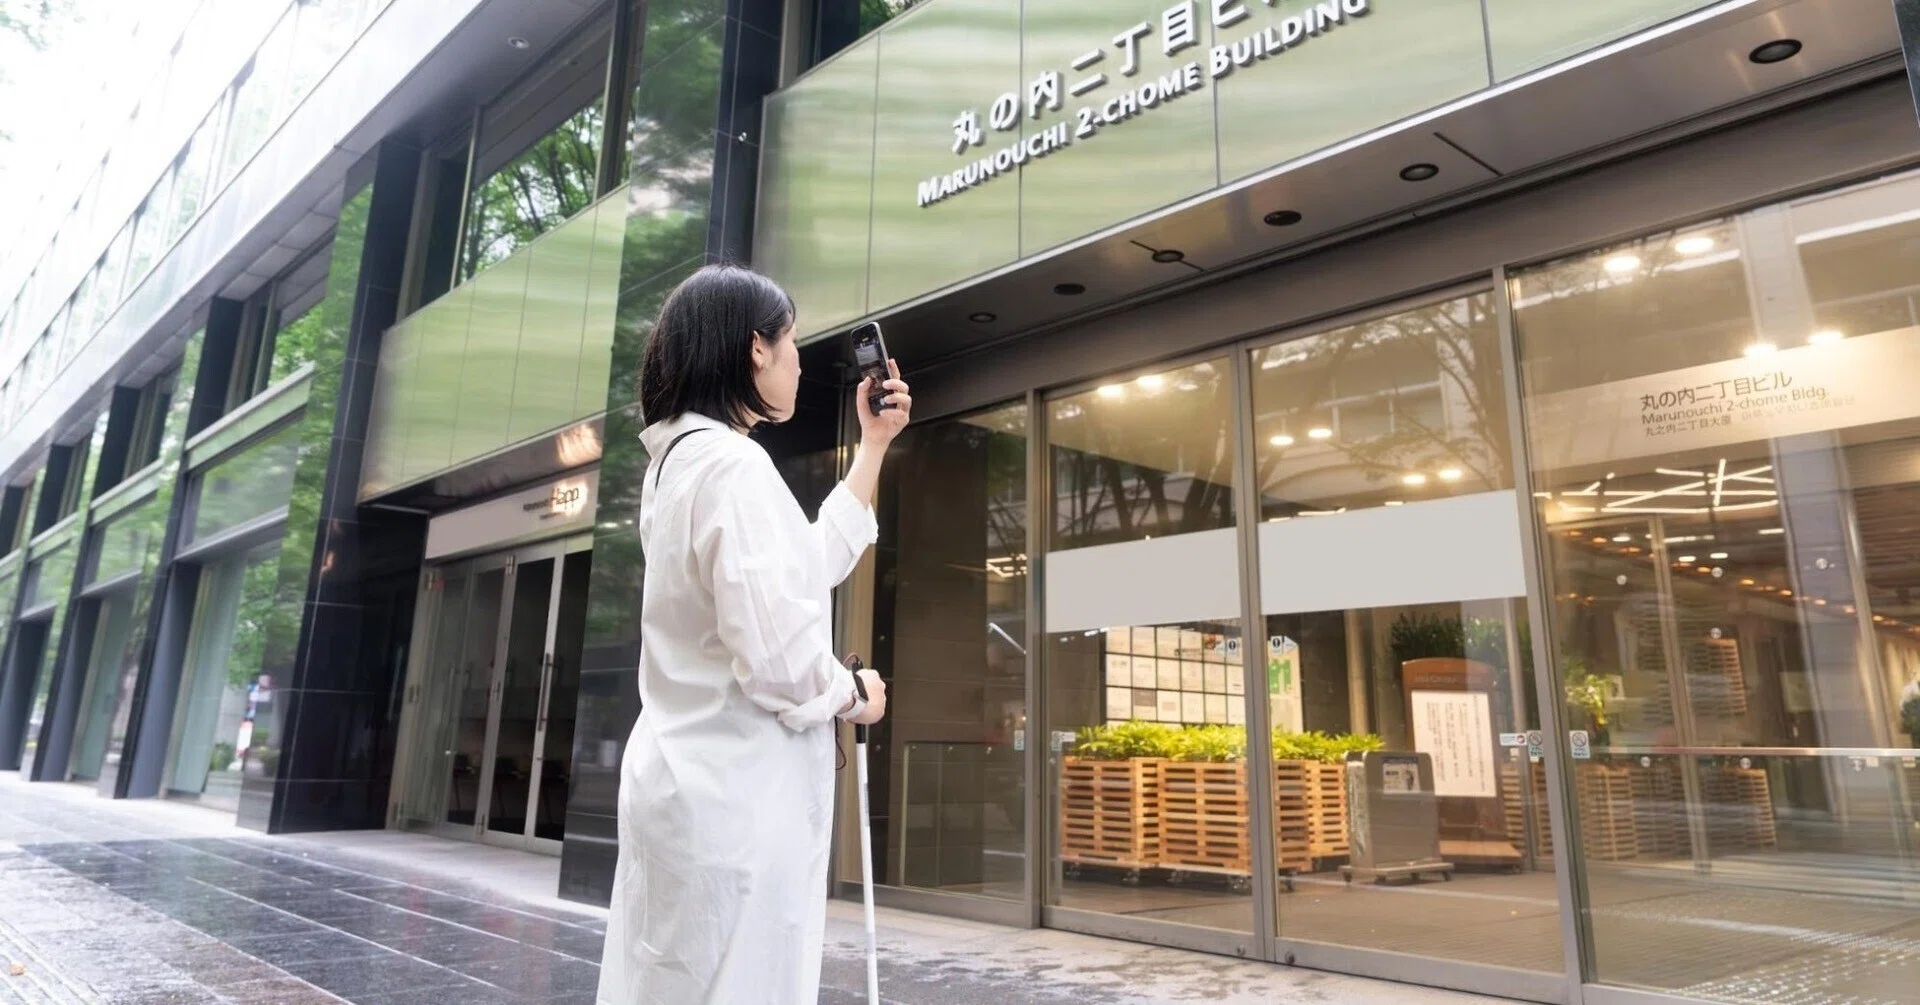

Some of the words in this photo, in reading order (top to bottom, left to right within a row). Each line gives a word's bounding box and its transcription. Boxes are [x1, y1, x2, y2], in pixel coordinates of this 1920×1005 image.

[951, 0, 1278, 153] 丸の内二丁目ビ
[917, 121, 1070, 207] MARUNOUCHI
[1074, 62, 1200, 139] 2-CHOME
[1640, 371, 1793, 411] 丸の内二丁目ビル
[1642, 404, 1723, 425] Marunouchi
[1726, 393, 1788, 413] 2-chome
[1791, 386, 1830, 401] Bldg.
